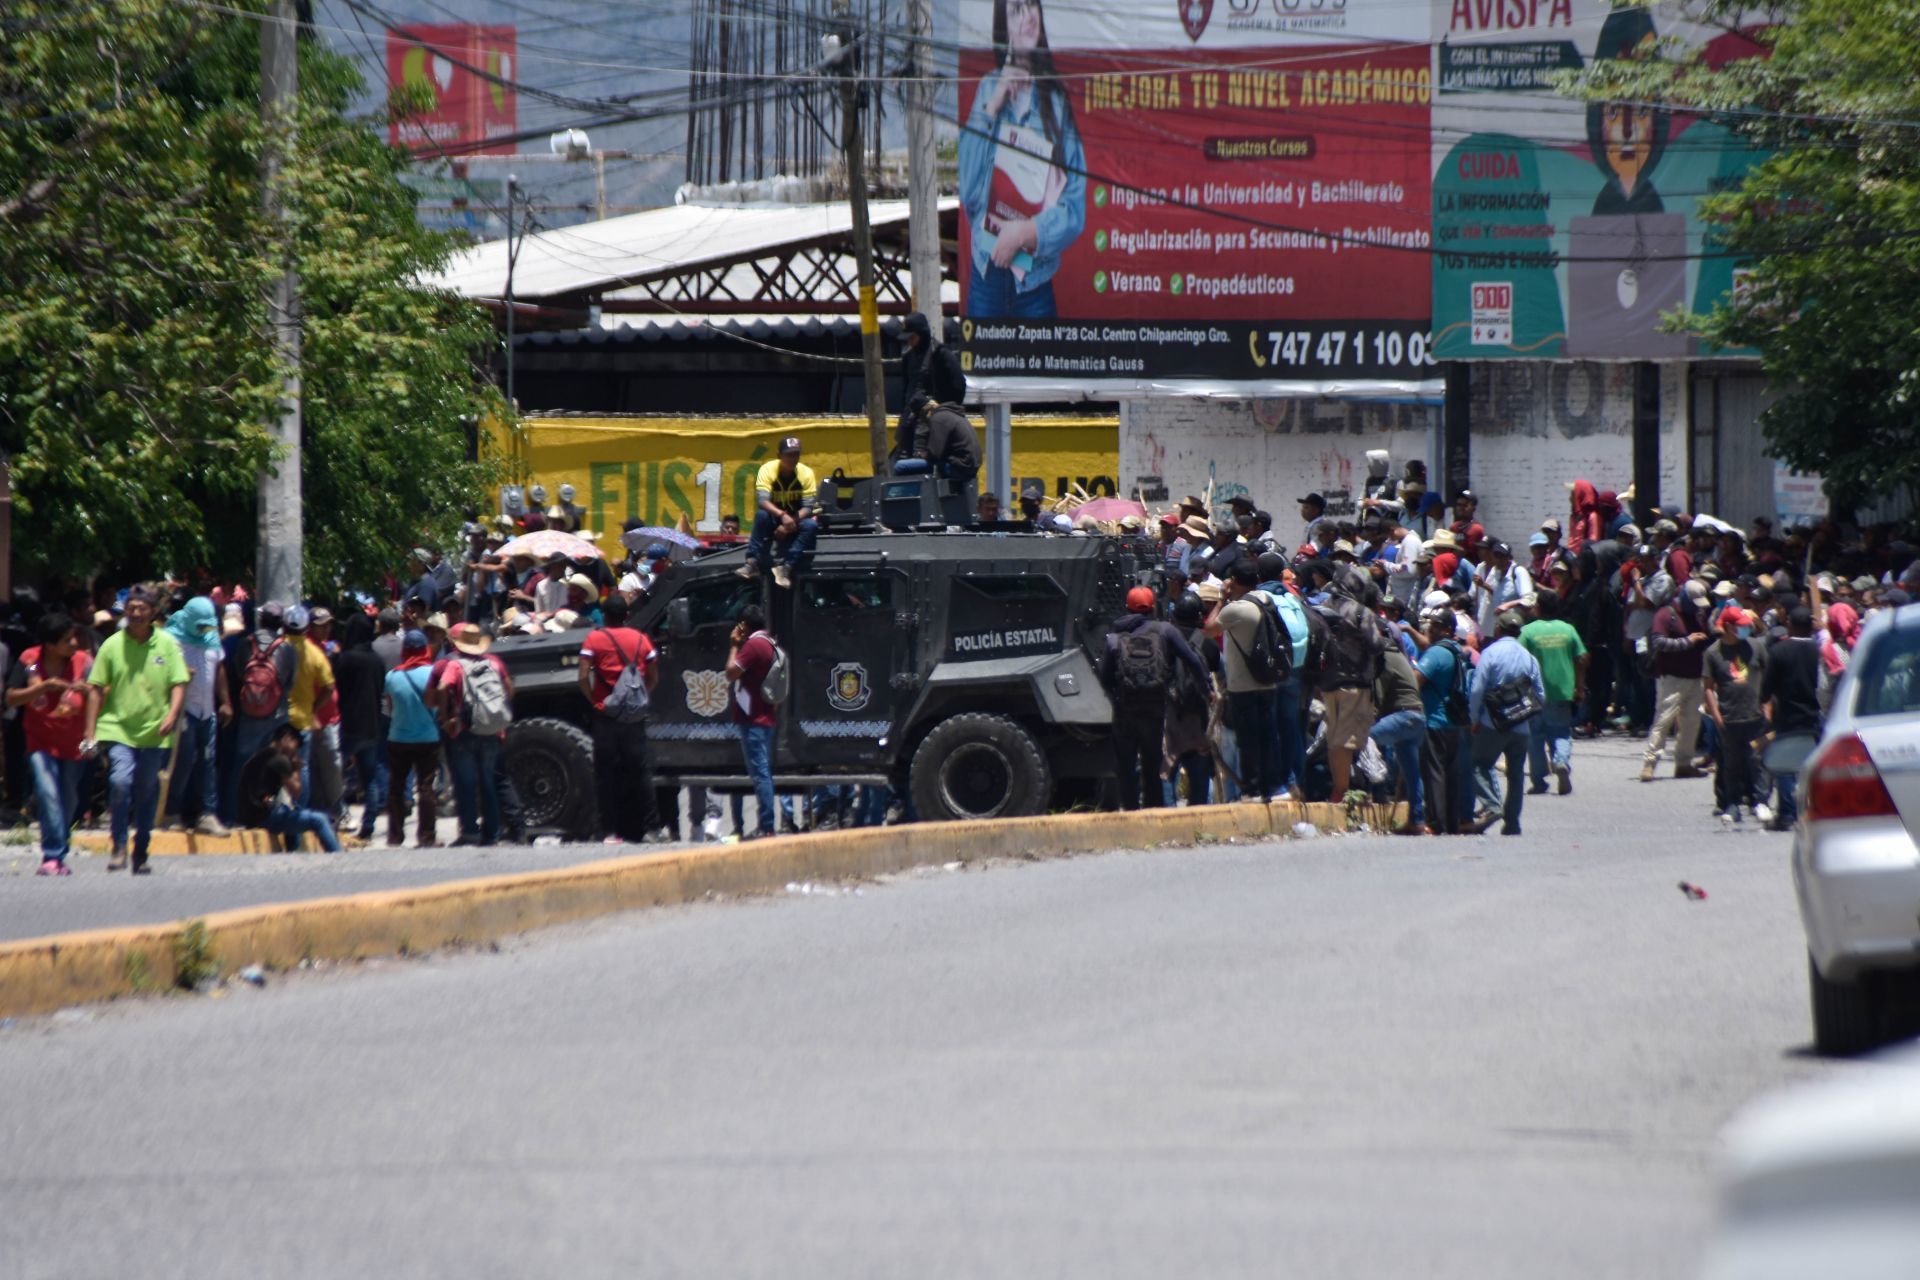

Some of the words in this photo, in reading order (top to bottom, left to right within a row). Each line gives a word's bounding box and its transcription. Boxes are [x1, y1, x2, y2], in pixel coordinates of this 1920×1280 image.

[1450, 47, 1474, 66] CON
[1475, 47, 1488, 65] EL
[1191, 72, 1219, 109] TU
[1228, 71, 1290, 108] NIVEL
[1300, 60, 1431, 107] ACADÉMICO
[1443, 68, 1464, 89] LAS
[1500, 68, 1509, 87] Y
[1510, 67, 1531, 87] LOS
[1216, 138, 1267, 158] Nuestros
[1269, 137, 1309, 156] Cursos
[1458, 151, 1520, 180] CUIDA
[1185, 183, 1199, 206] la
[1203, 181, 1293, 205] Universidad
[1297, 184, 1306, 209] y
[1311, 180, 1404, 204] Bachillerato
[1438, 192, 1455, 213] LA
[1458, 187, 1551, 211] INFORMACIÓN
[1110, 228, 1212, 255] Regularización
[1215, 234, 1246, 255] para
[1250, 226, 1327, 249] Secundaria
[1439, 224, 1459, 242] QUE
[1439, 252, 1465, 270] TUS
[1110, 271, 1162, 292] Verano
[1186, 272, 1295, 299] Propedéuticos
[1475, 288, 1508, 308] 911
[975, 325, 1017, 340] Andador
[1018, 326, 1051, 342] Zapata
[1080, 326, 1101, 342] Col.
[1102, 327, 1137, 342] Centro
[1139, 326, 1206, 346] Chilpancingo
[1208, 327, 1231, 343] Gro.
[1268, 331, 1311, 366] 747
[1316, 330, 1346, 366] 47
[1353, 330, 1364, 365] 1
[1373, 330, 1403, 366] 10
[974, 354, 1026, 370] Academia
[1028, 354, 1042, 369] de
[1044, 354, 1106, 371] Matemática
[1109, 355, 1145, 372] Gauss
[954, 630, 1003, 652] POLICÍA
[1005, 627, 1057, 646] ESTATAL
